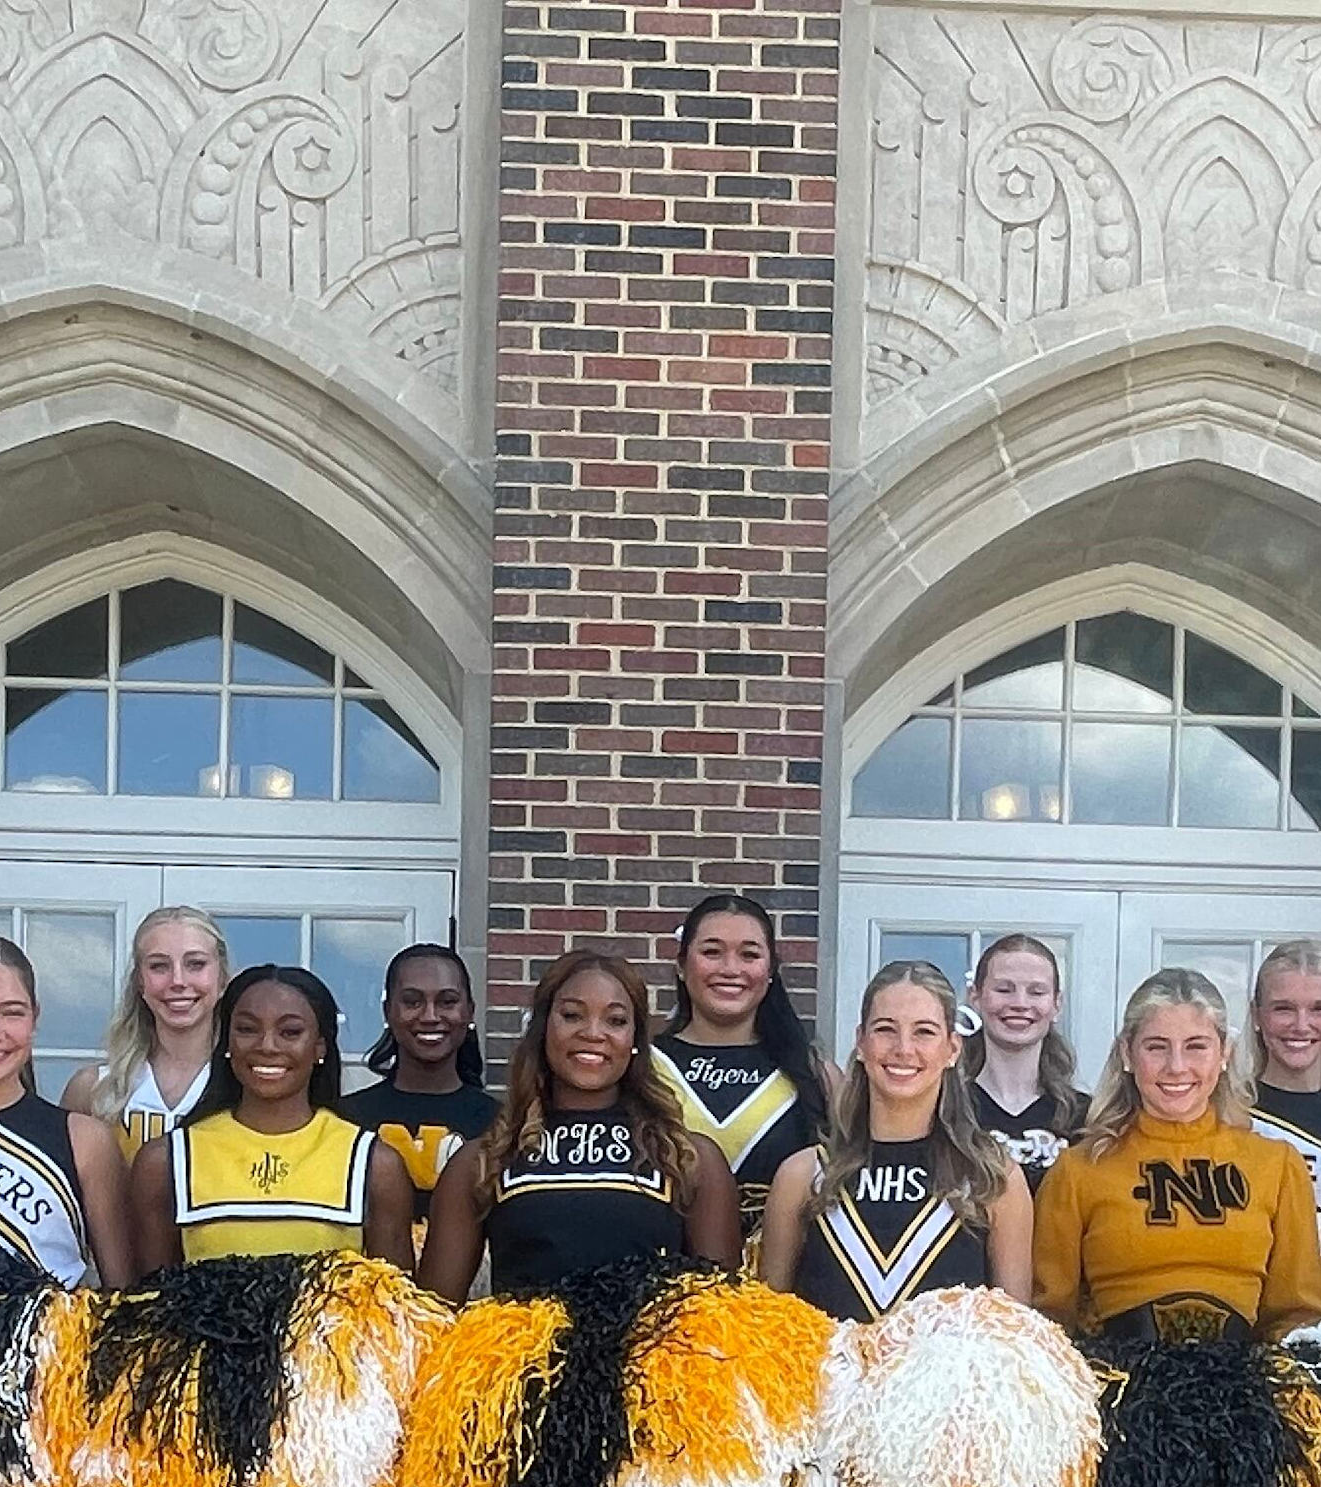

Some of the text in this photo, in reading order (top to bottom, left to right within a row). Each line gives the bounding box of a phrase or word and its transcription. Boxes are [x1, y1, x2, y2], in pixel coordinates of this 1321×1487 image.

[684, 1056, 765, 1090] Tigers
[527, 1123, 632, 1165] NHS
[855, 1164, 928, 1202] NHS
